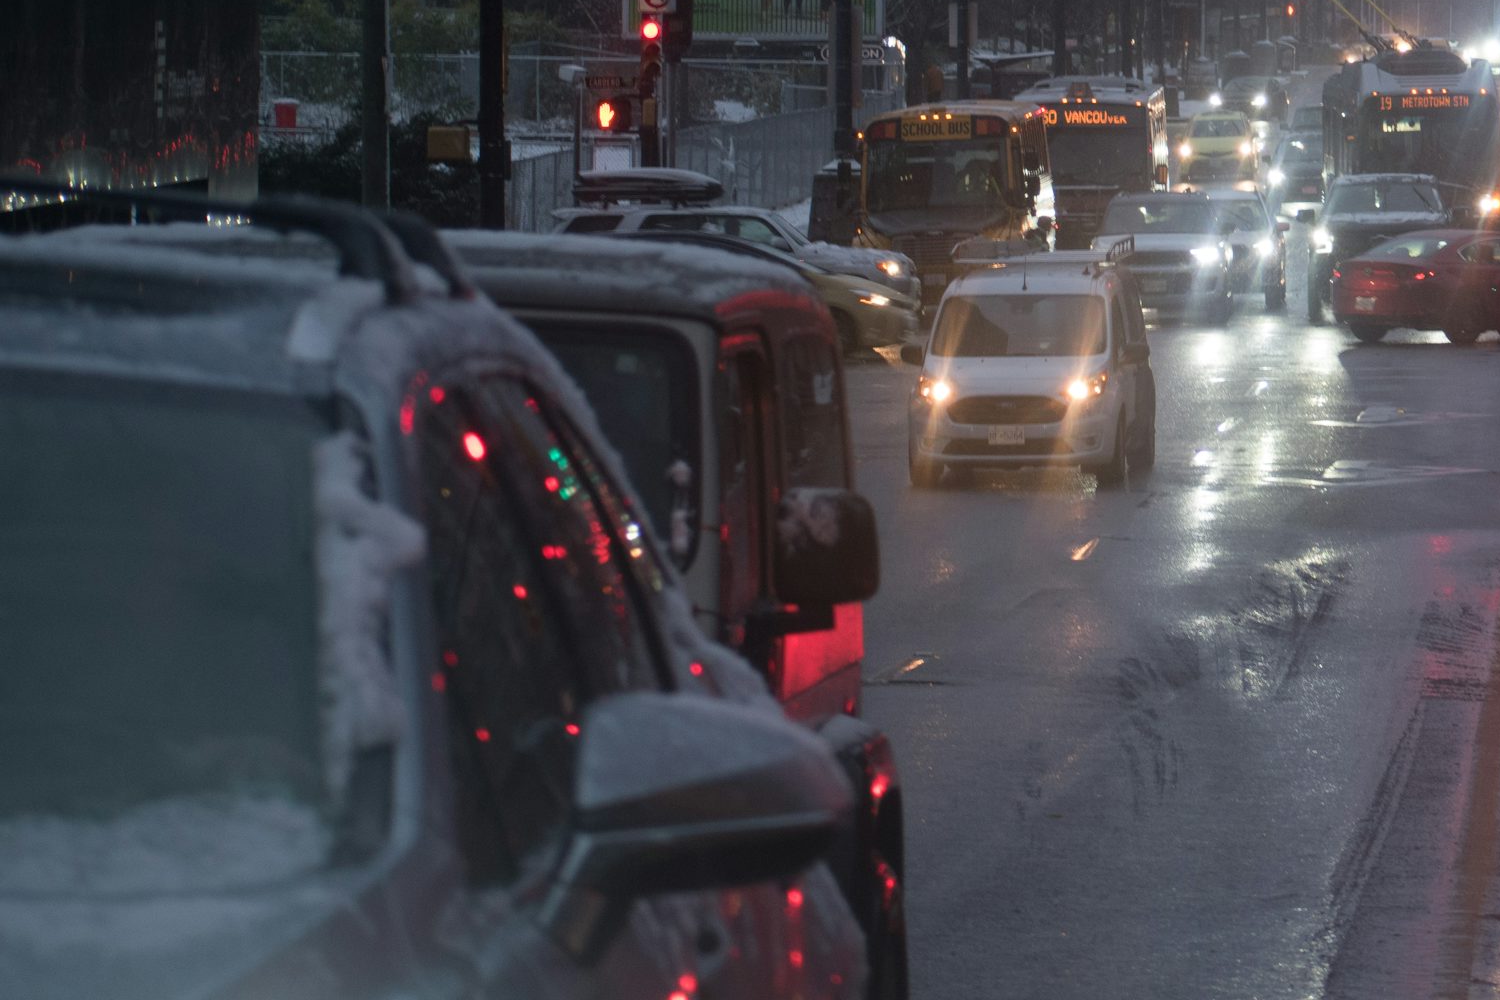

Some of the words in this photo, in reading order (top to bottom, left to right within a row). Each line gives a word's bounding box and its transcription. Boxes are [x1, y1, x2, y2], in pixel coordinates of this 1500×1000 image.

[1379, 96, 1393, 111] 19
[1402, 96, 1451, 109] METROTOWN
[1064, 109, 1128, 125] VANCOUVER
[902, 121, 945, 137] SCHOOL
[948, 121, 970, 136] BUS
